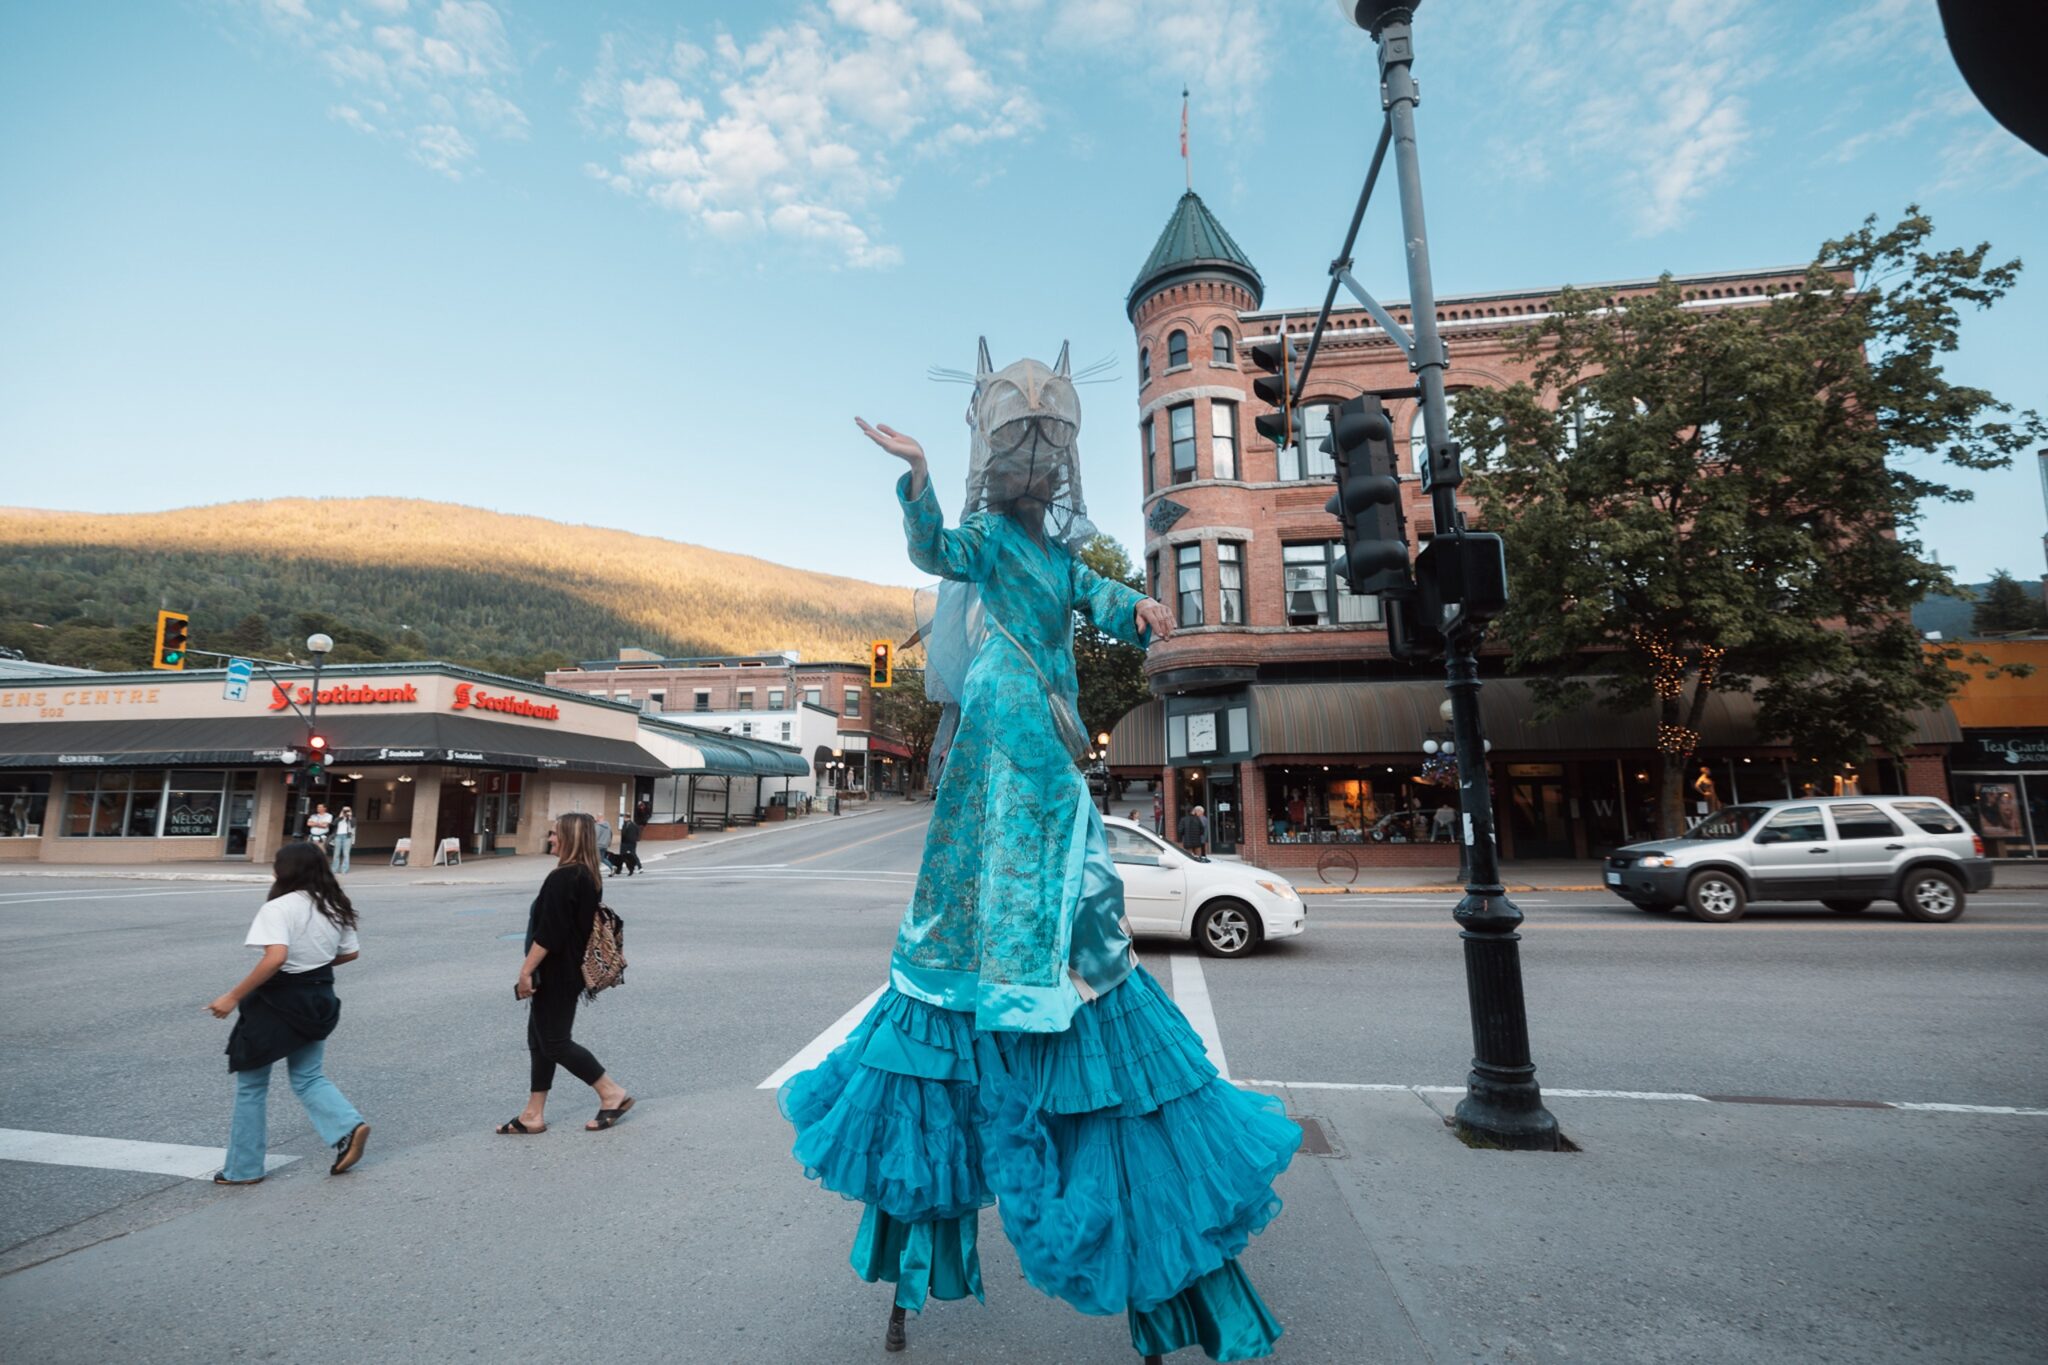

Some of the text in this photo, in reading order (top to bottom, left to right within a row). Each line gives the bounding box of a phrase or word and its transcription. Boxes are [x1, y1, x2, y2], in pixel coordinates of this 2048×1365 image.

[1, 688, 160, 708] ENS CENTRE
[475, 691, 559, 720] Scotiabank
[40, 707, 64, 718] 502
[1978, 739, 2005, 752] Tea
[1592, 800, 1614, 817] W
[171, 814, 212, 825] NELSON
